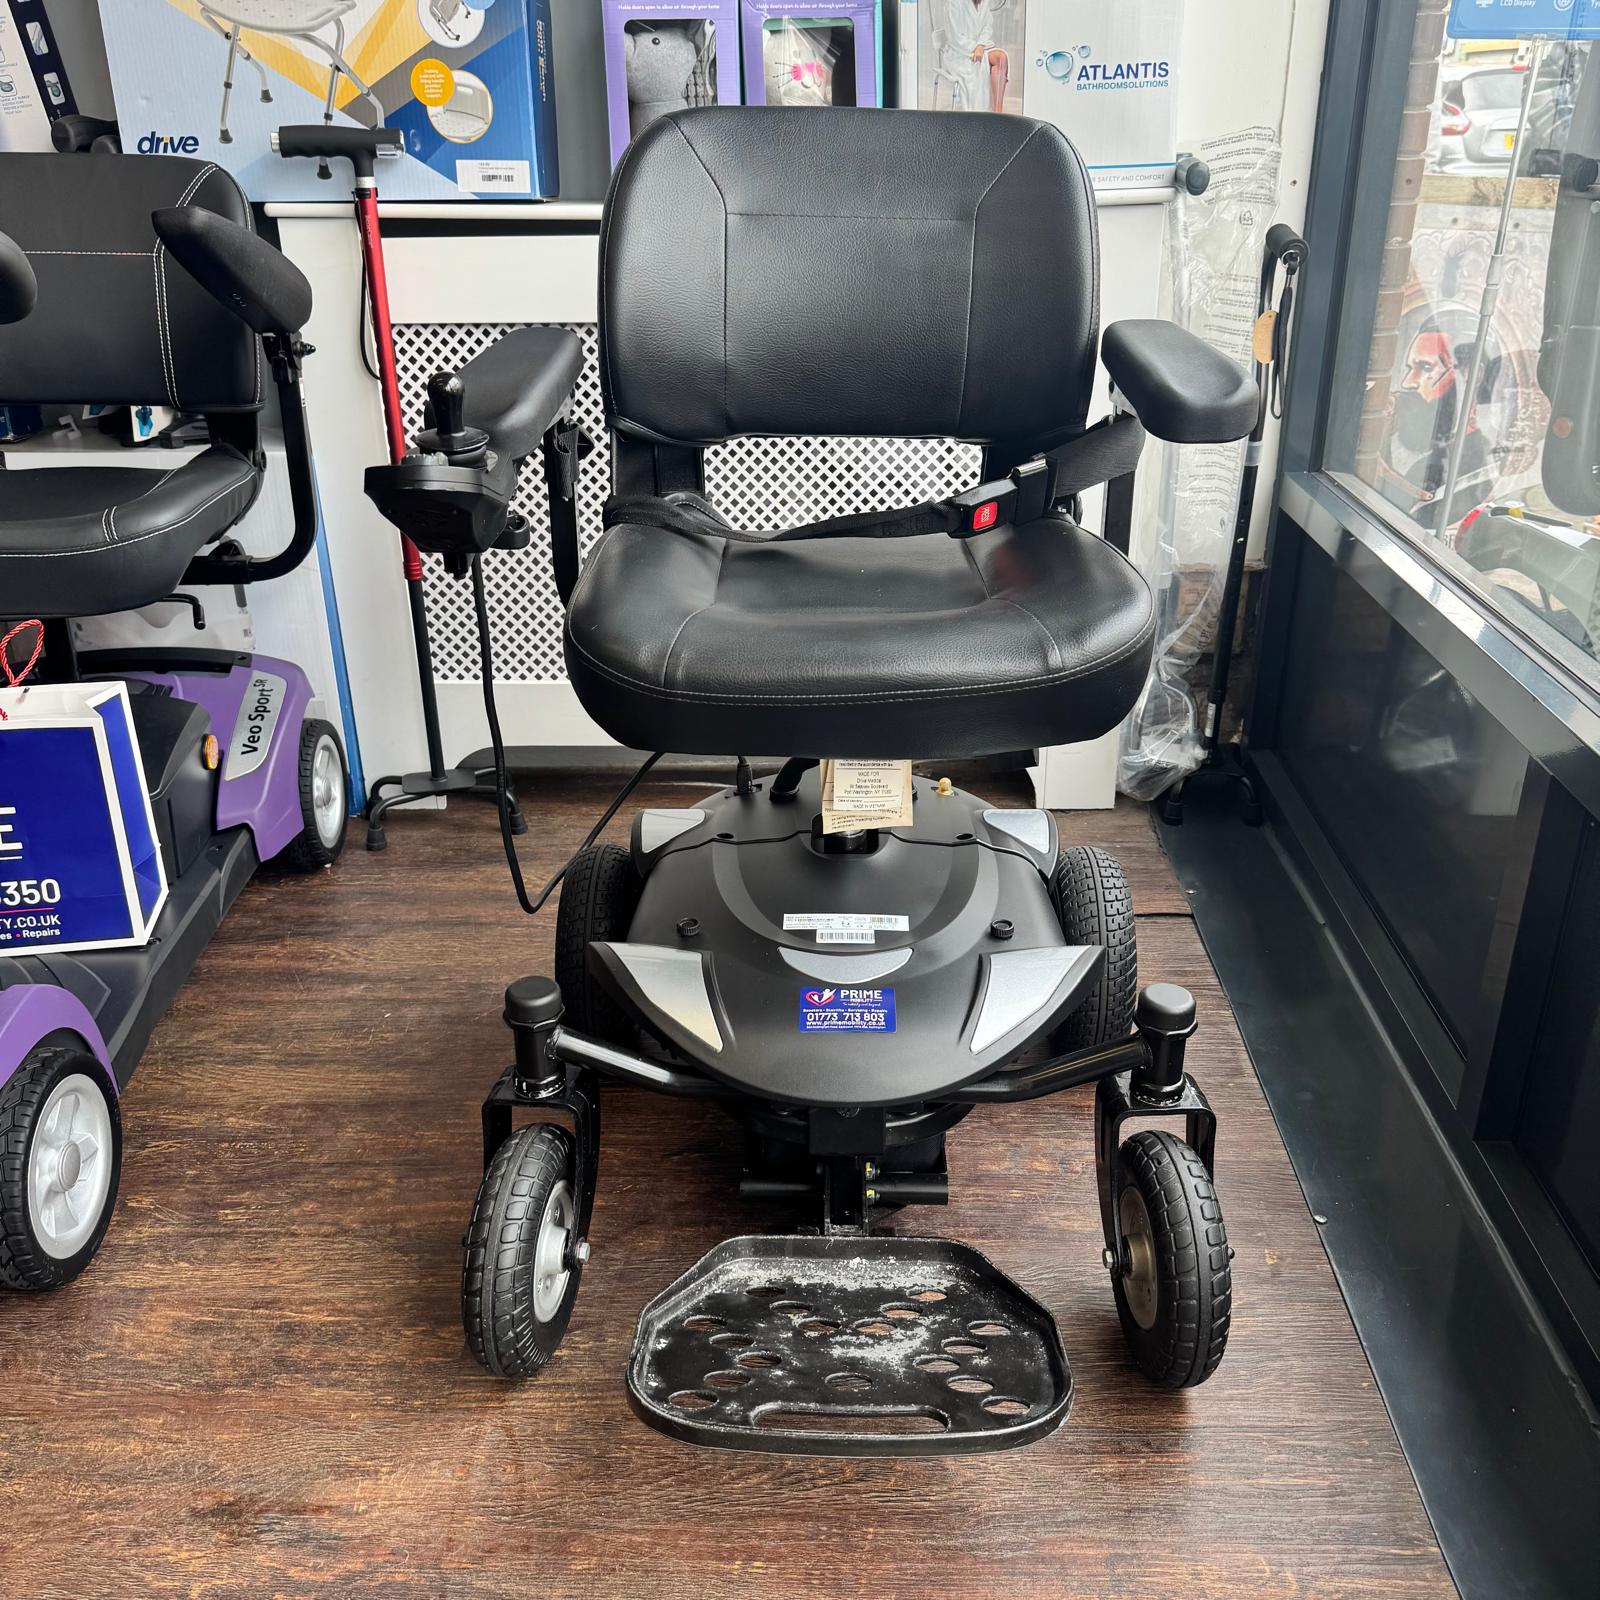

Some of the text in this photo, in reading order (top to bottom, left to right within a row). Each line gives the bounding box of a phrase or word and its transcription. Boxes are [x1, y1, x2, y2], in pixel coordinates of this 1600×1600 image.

[1077, 62, 1169, 81] ATLANTIS
[1077, 80, 1169, 91] BATHROOMSOLUTIONS
[137, 130, 200, 155] drive
[1097, 175, 1120, 183] SAFETY
[1120, 174, 1134, 182] AND
[1135, 173, 1165, 182] COMFORT
[241, 725, 263, 756] Veo
[0, 878, 61, 906] 350
[23, 928, 61, 939] Repairs
[841, 989, 883, 999] PRIME
[807, 1012, 885, 1022] 01773 713 803
